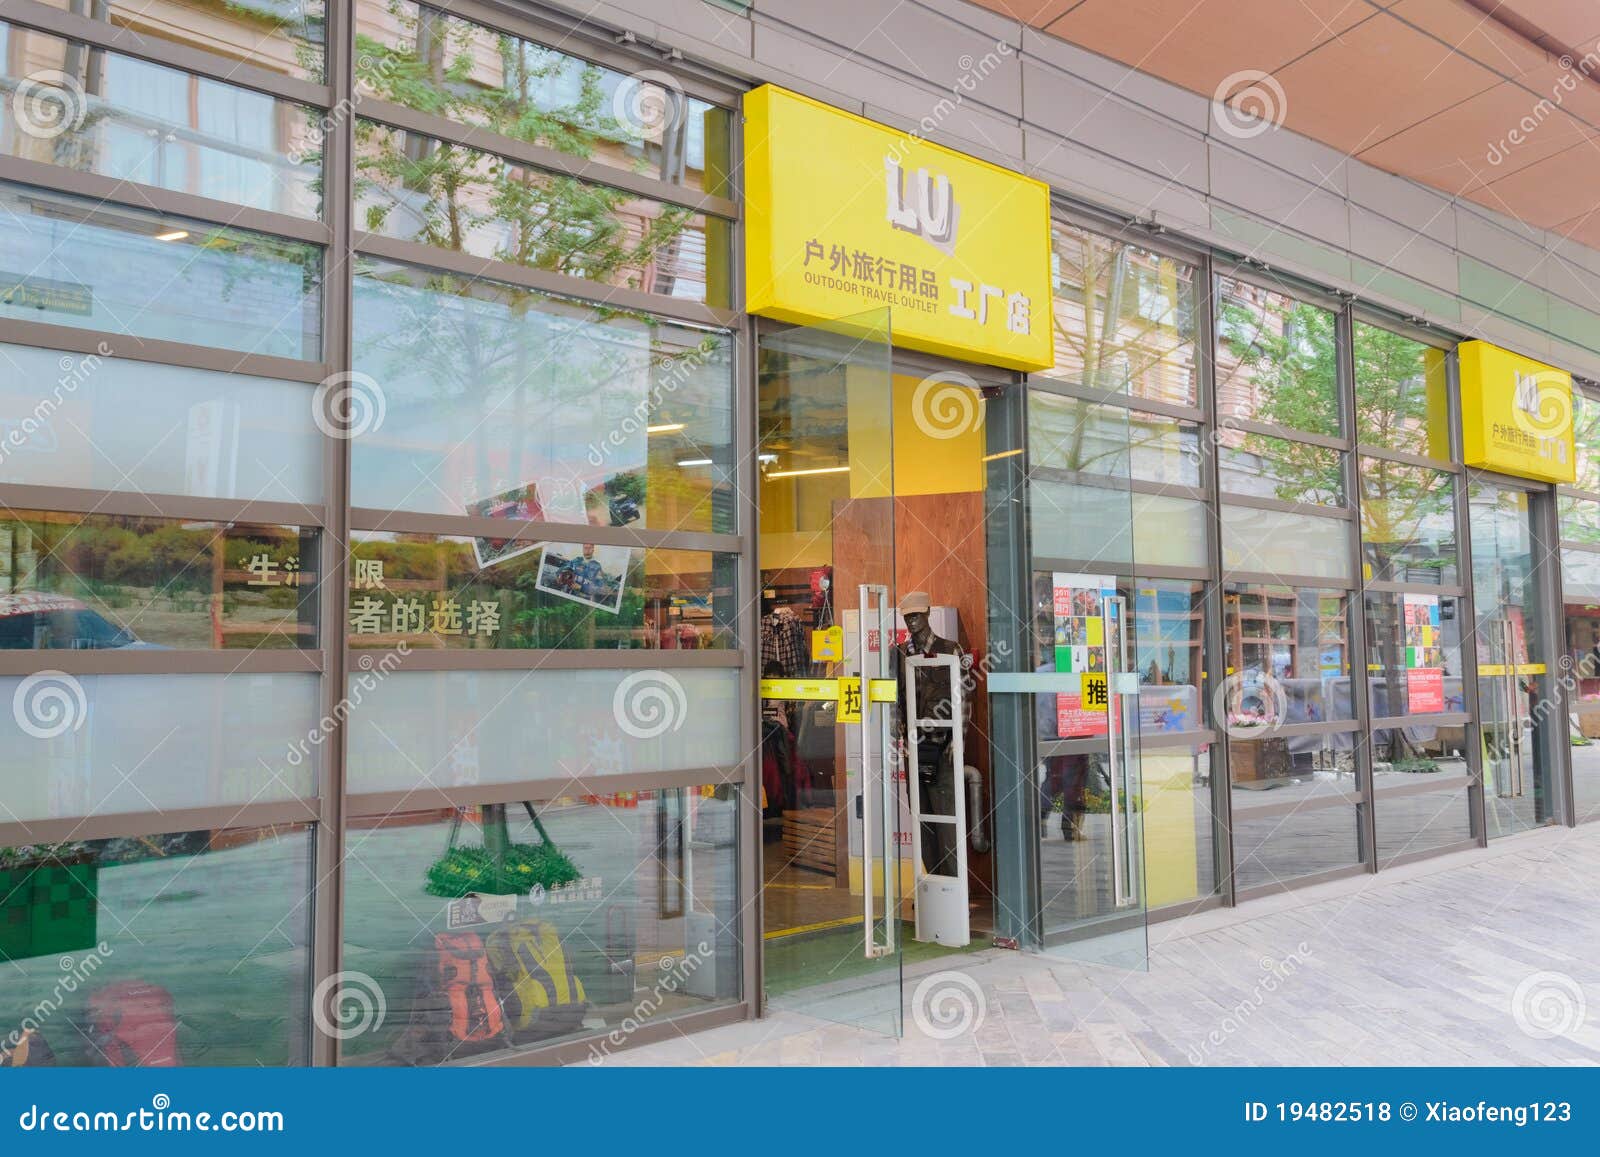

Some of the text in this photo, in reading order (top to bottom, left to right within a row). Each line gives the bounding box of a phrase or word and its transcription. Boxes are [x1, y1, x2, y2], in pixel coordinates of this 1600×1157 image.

[884, 154, 955, 243] LU
[803, 238, 939, 300] 户外旅行用品
[804, 271, 938, 314] OUTDOOR TRAVEL OUTLET
[949, 277, 1031, 336] 工厂店
[349, 596, 501, 637] 者的选择
[1087, 679, 1107, 705] 推
